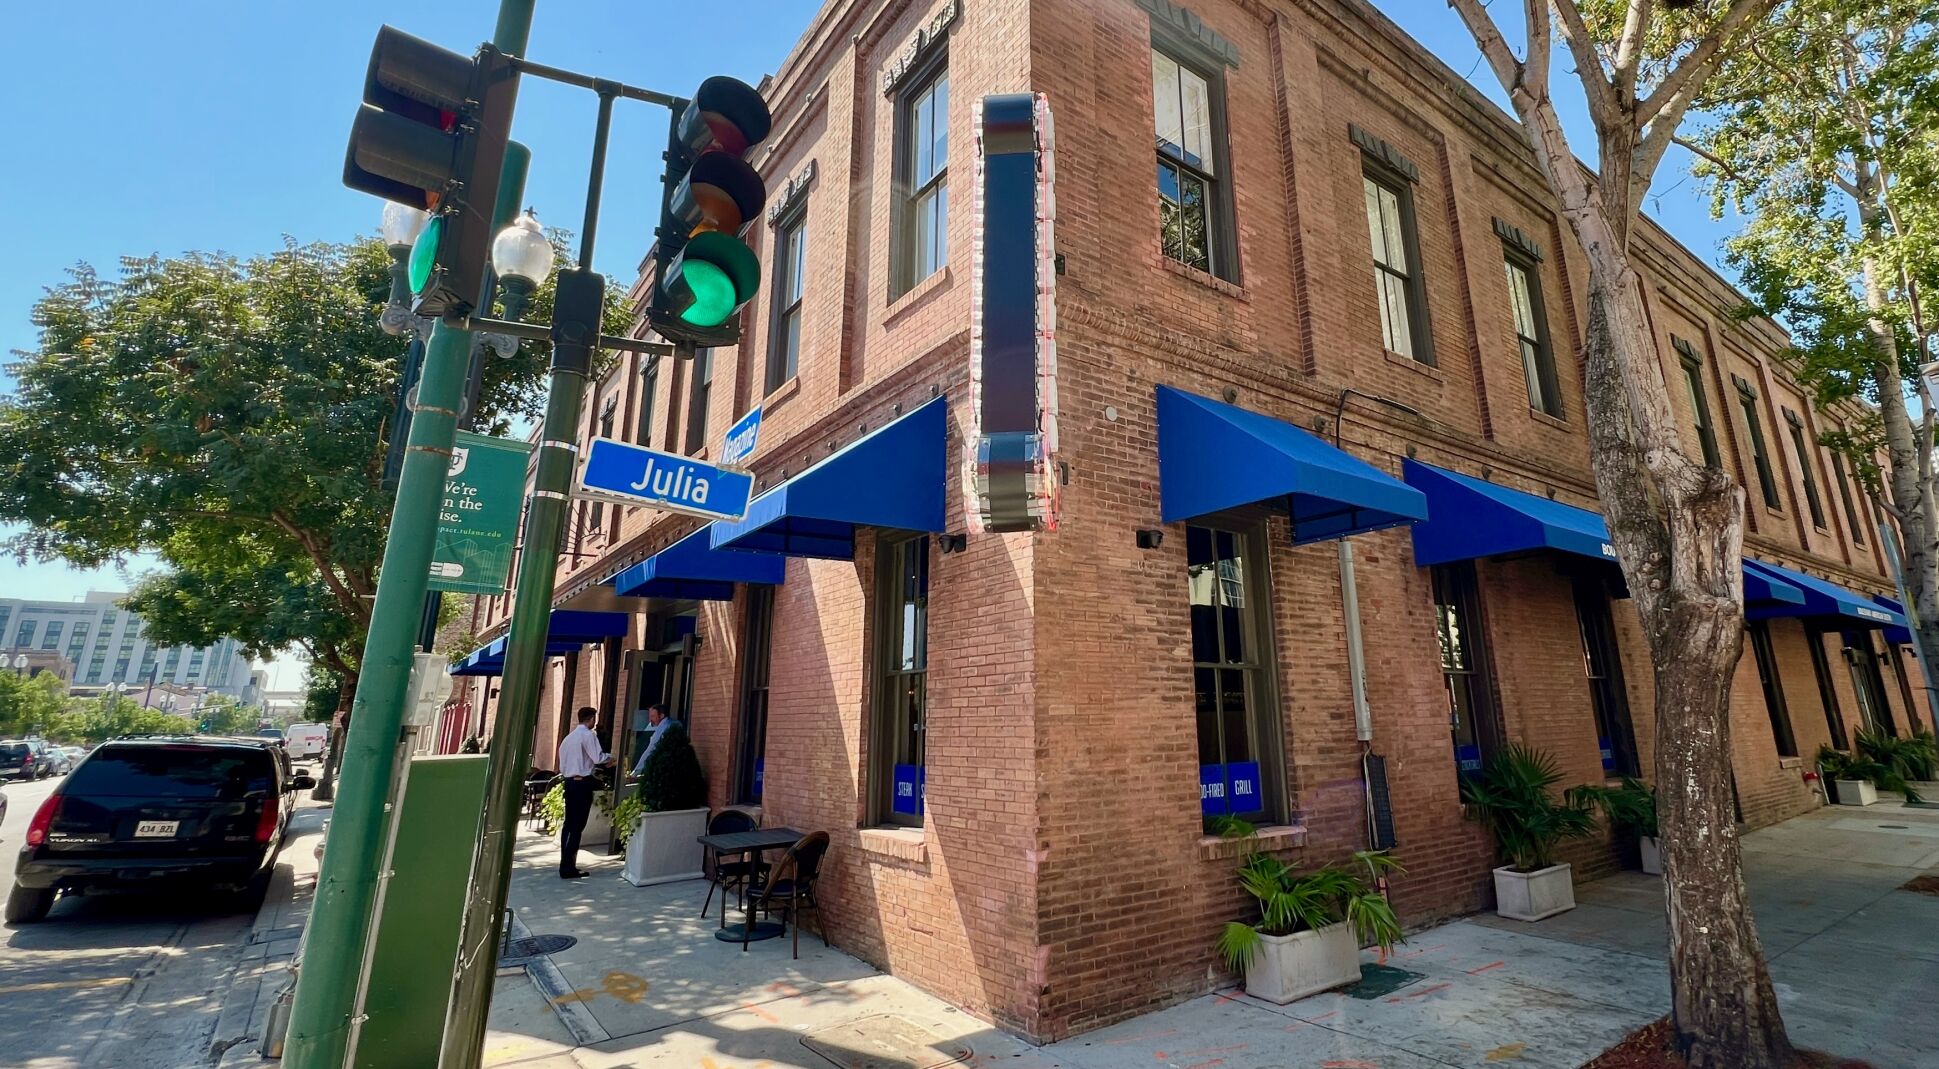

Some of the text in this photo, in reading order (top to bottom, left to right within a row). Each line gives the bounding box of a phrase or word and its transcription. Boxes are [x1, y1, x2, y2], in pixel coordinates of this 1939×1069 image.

[630, 457, 709, 504] Julia
[444, 497, 483, 511] n the
[440, 508, 462, 523] ise.
[438, 525, 502, 538] pact.tulane.edu
[1601, 543, 1616, 558] BOU
[1234, 779, 1253, 795] GRILL
